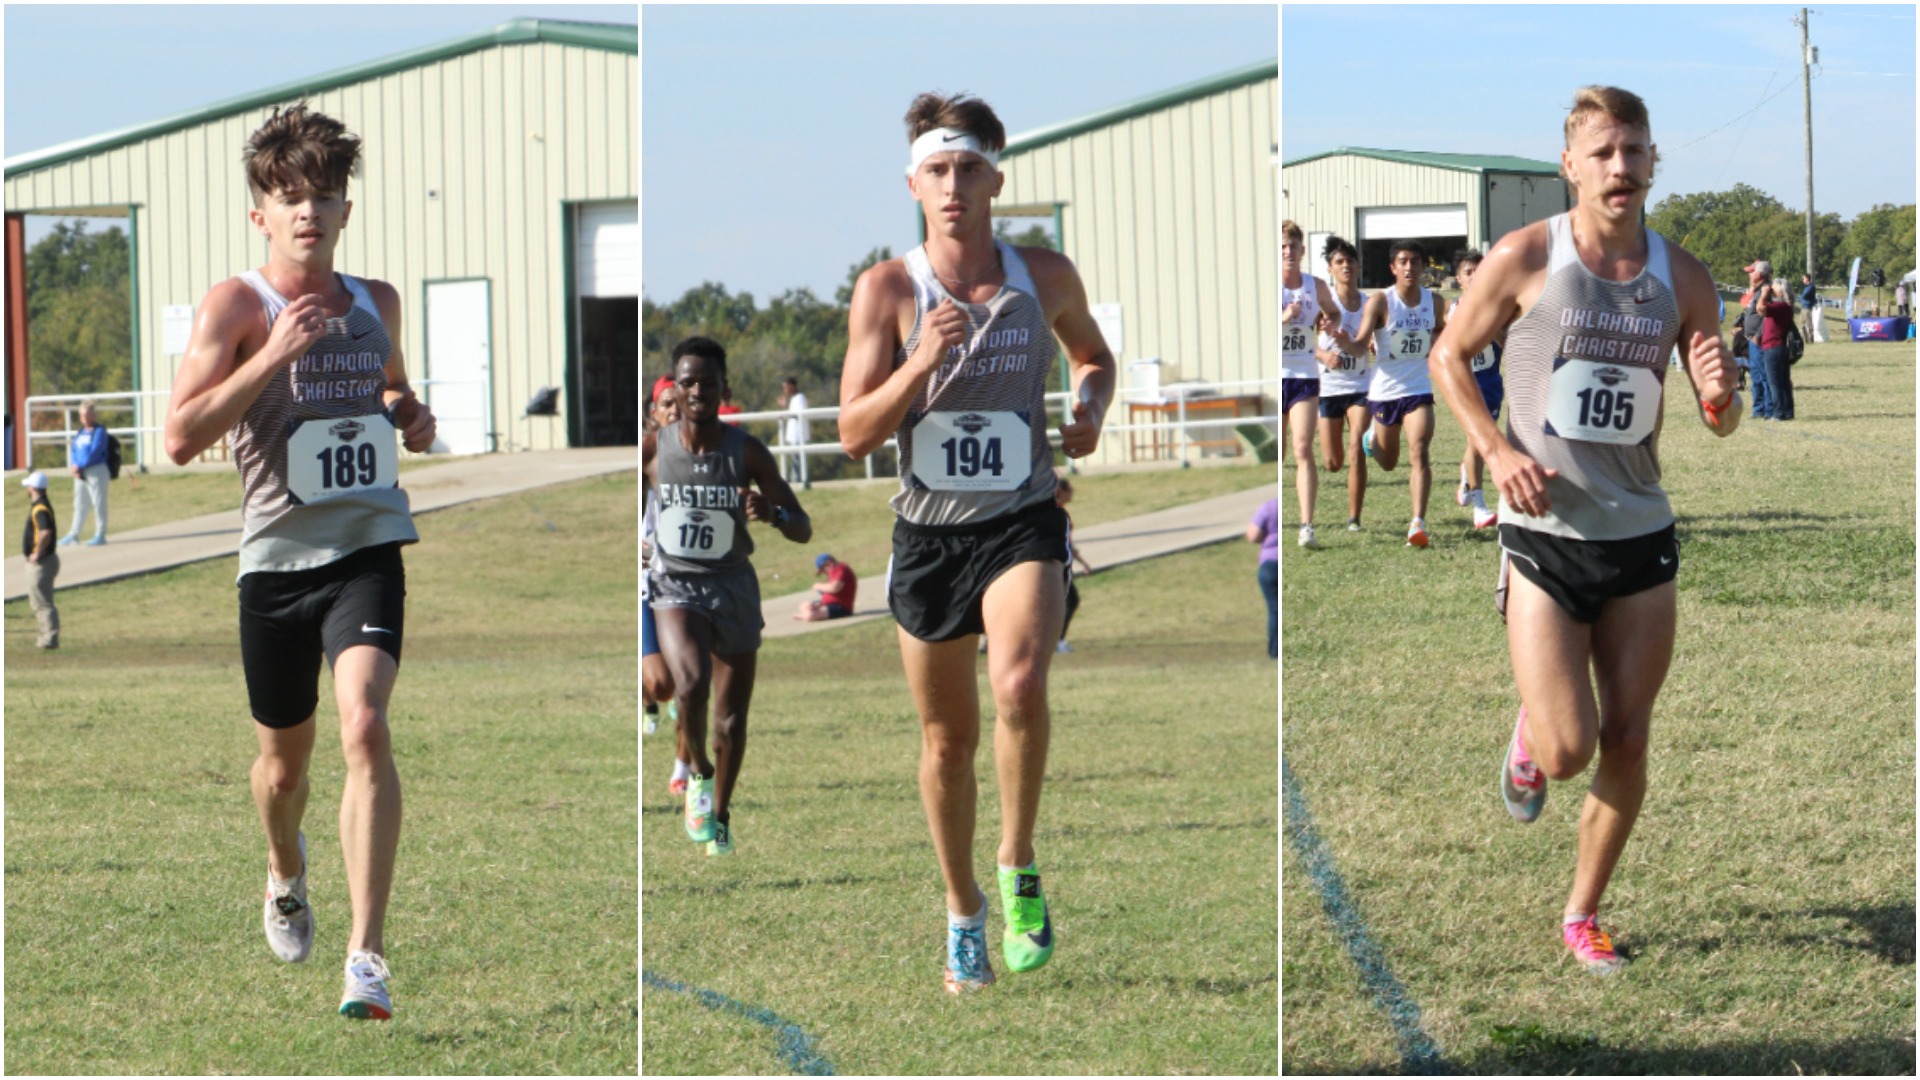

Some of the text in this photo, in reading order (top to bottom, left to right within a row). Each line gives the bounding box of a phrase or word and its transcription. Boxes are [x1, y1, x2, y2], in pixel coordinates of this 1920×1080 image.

[1560, 308, 1663, 337] OKLAHOMA
[1283, 335, 1305, 350] 268
[1401, 339, 1422, 353] 267
[1563, 335, 1659, 364] CHRISTIAN
[1338, 356, 1356, 370] 01
[1577, 388, 1635, 430] 195
[316, 442, 376, 489] 189
[941, 436, 1003, 477] 194
[660, 483, 739, 508] EASTERN
[678, 523, 714, 549] 176
